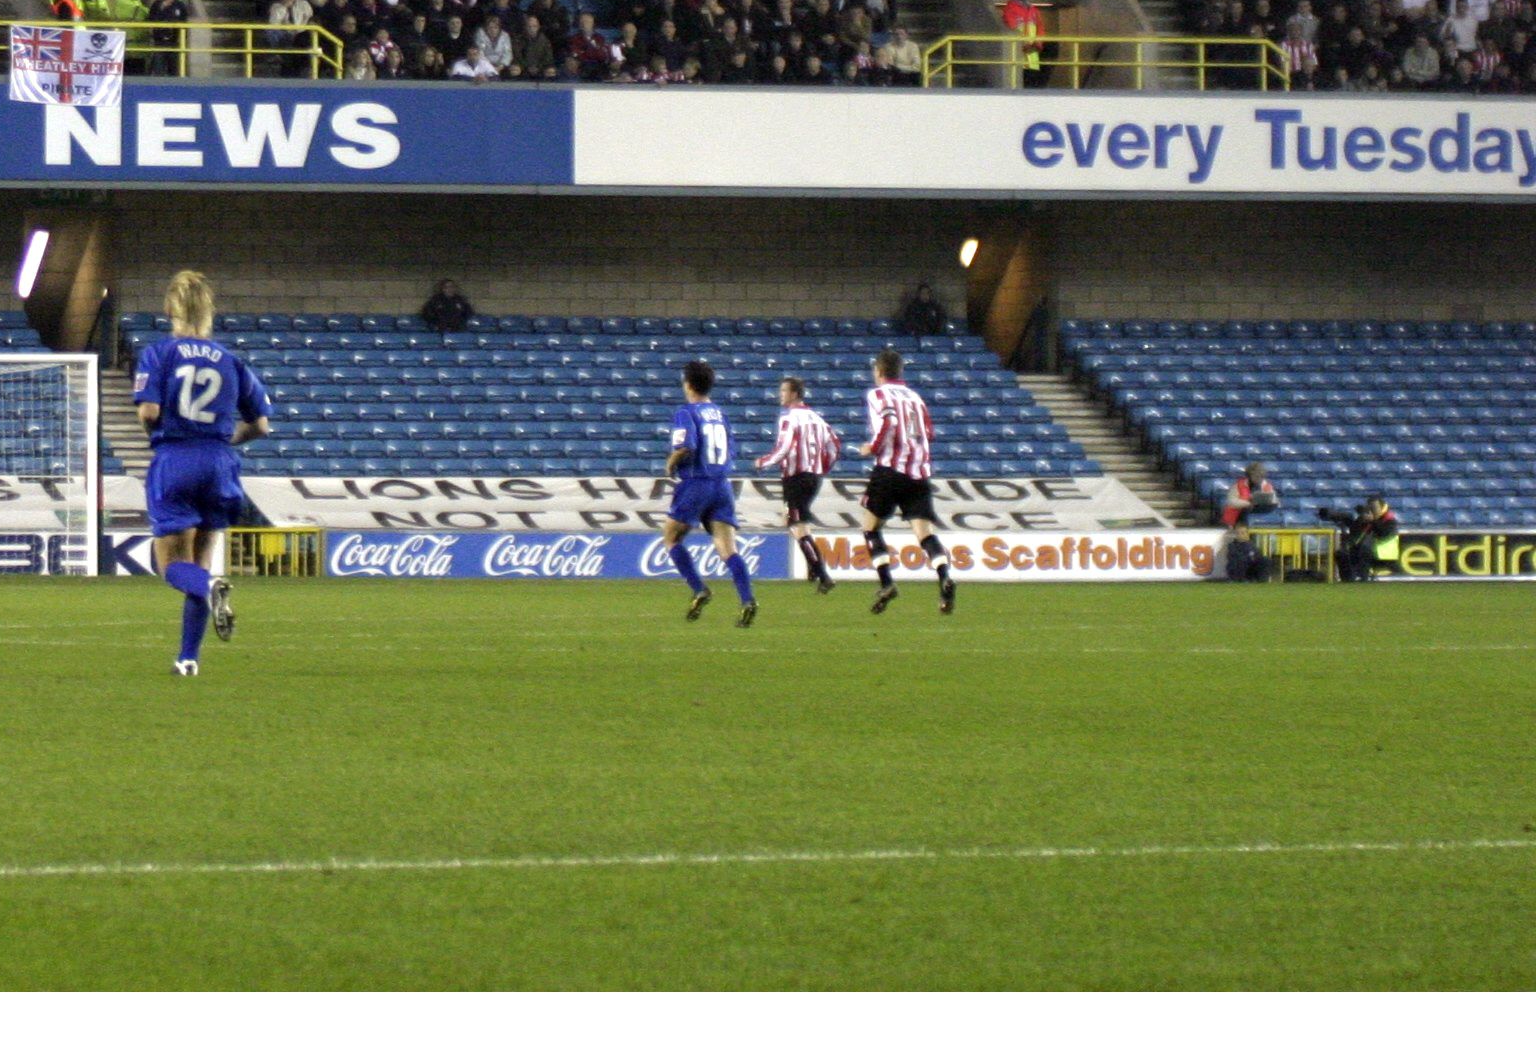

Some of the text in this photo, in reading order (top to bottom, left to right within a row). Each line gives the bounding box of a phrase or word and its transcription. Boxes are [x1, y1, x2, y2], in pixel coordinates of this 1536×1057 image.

[15, 58, 87, 73] WHEATLEY
[42, 83, 92, 96] PIRATE
[44, 102, 401, 170] NEWS
[1022, 122, 1224, 184] every
[177, 342, 223, 363] WARD
[175, 364, 223, 424] 12
[291, 478, 553, 501] LIONS
[370, 510, 546, 530] NOT
[329, 533, 461, 577] Coca-Cola
[482, 533, 611, 577] Coca-Cola
[981, 536, 1214, 575] Scaffolding
